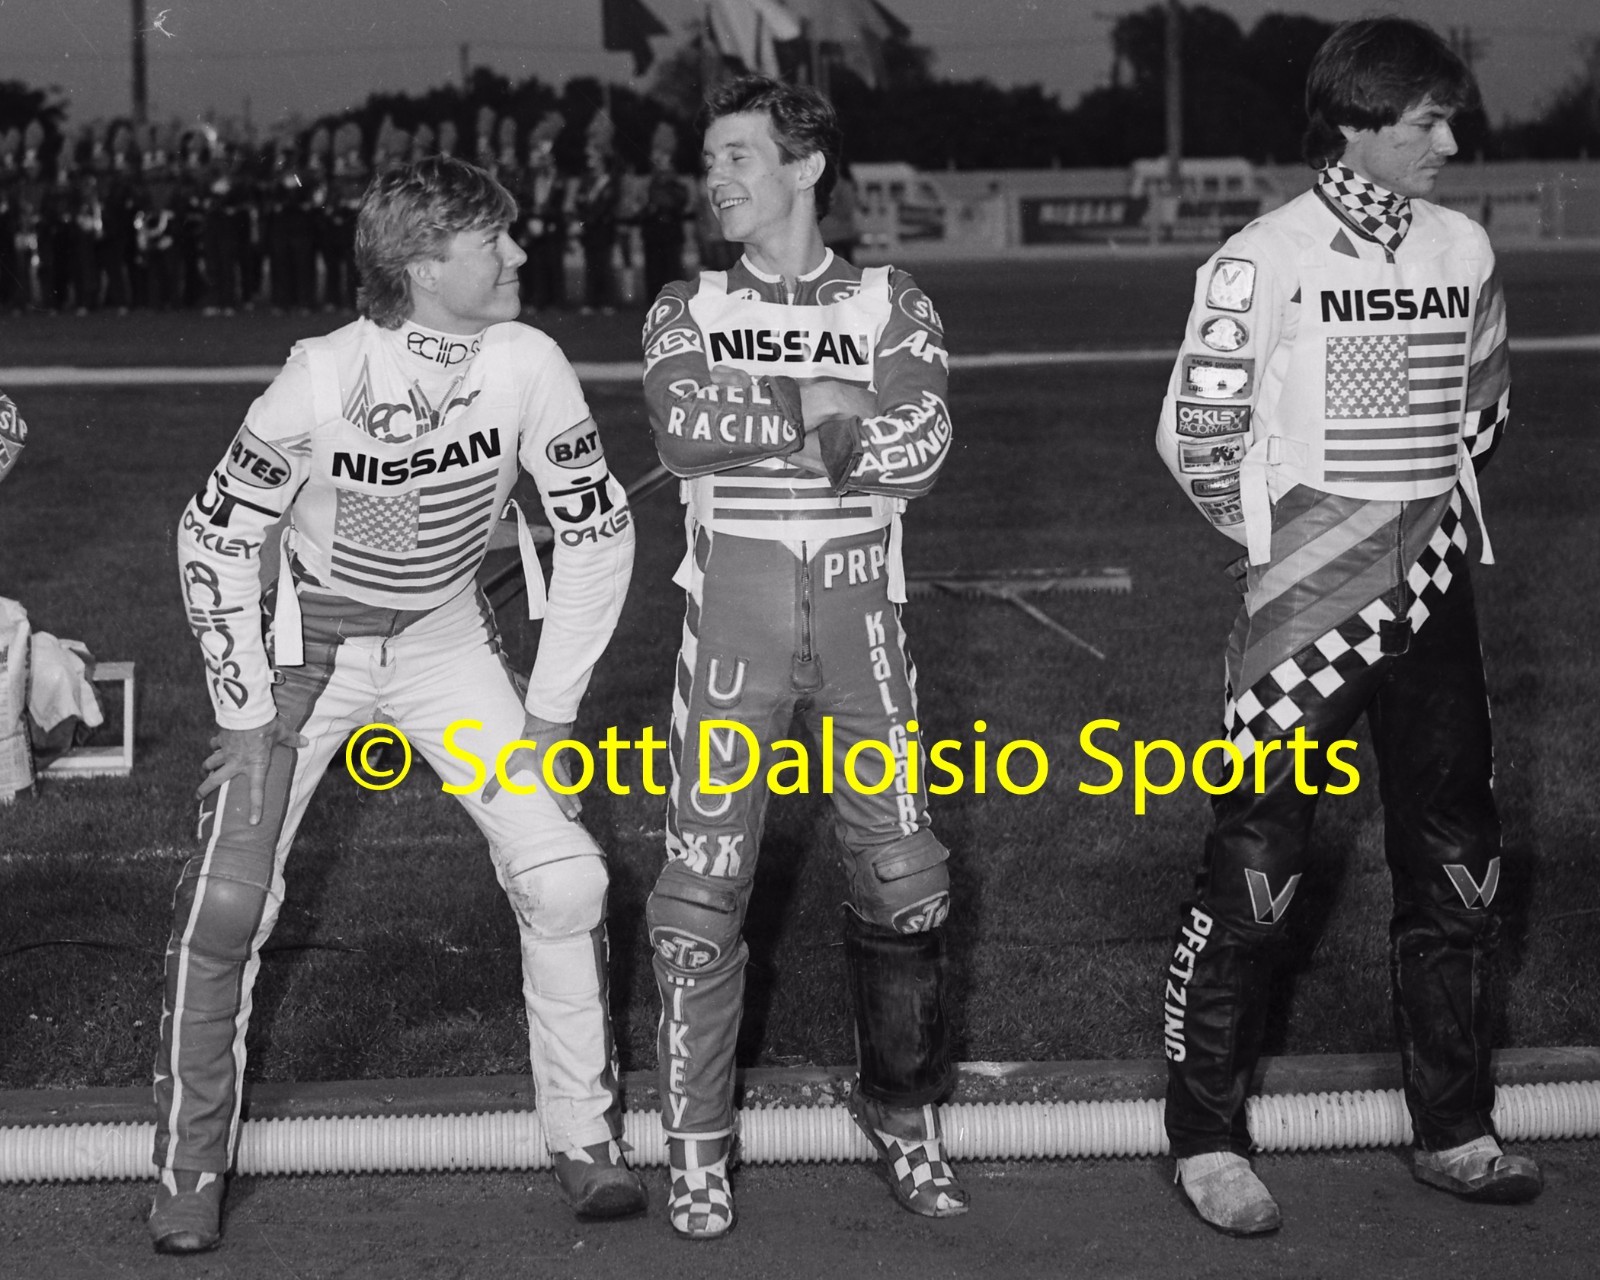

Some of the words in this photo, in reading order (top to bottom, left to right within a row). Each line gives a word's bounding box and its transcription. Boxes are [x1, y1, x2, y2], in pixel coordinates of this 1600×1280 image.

[834, 285, 862, 302] ST
[1321, 285, 1470, 322] NISSAN
[645, 331, 698, 360] KLEY
[708, 327, 870, 366] NISSAN
[667, 405, 797, 445] RACING
[1180, 407, 1246, 425] OAKLEY
[1180, 420, 1220, 434] FACTORY
[230, 441, 288, 486] ATES
[332, 428, 502, 486] NISSAN
[850, 414, 950, 477] ACING
[184, 510, 261, 559] OAKLEY
[560, 505, 630, 547] OAKLE
[823, 544, 886, 589] PRP
[903, 897, 948, 934] STP
[658, 936, 711, 968] STP
[1164, 907, 1213, 1063] PFETZING
[666, 975, 695, 1128] IKEY
